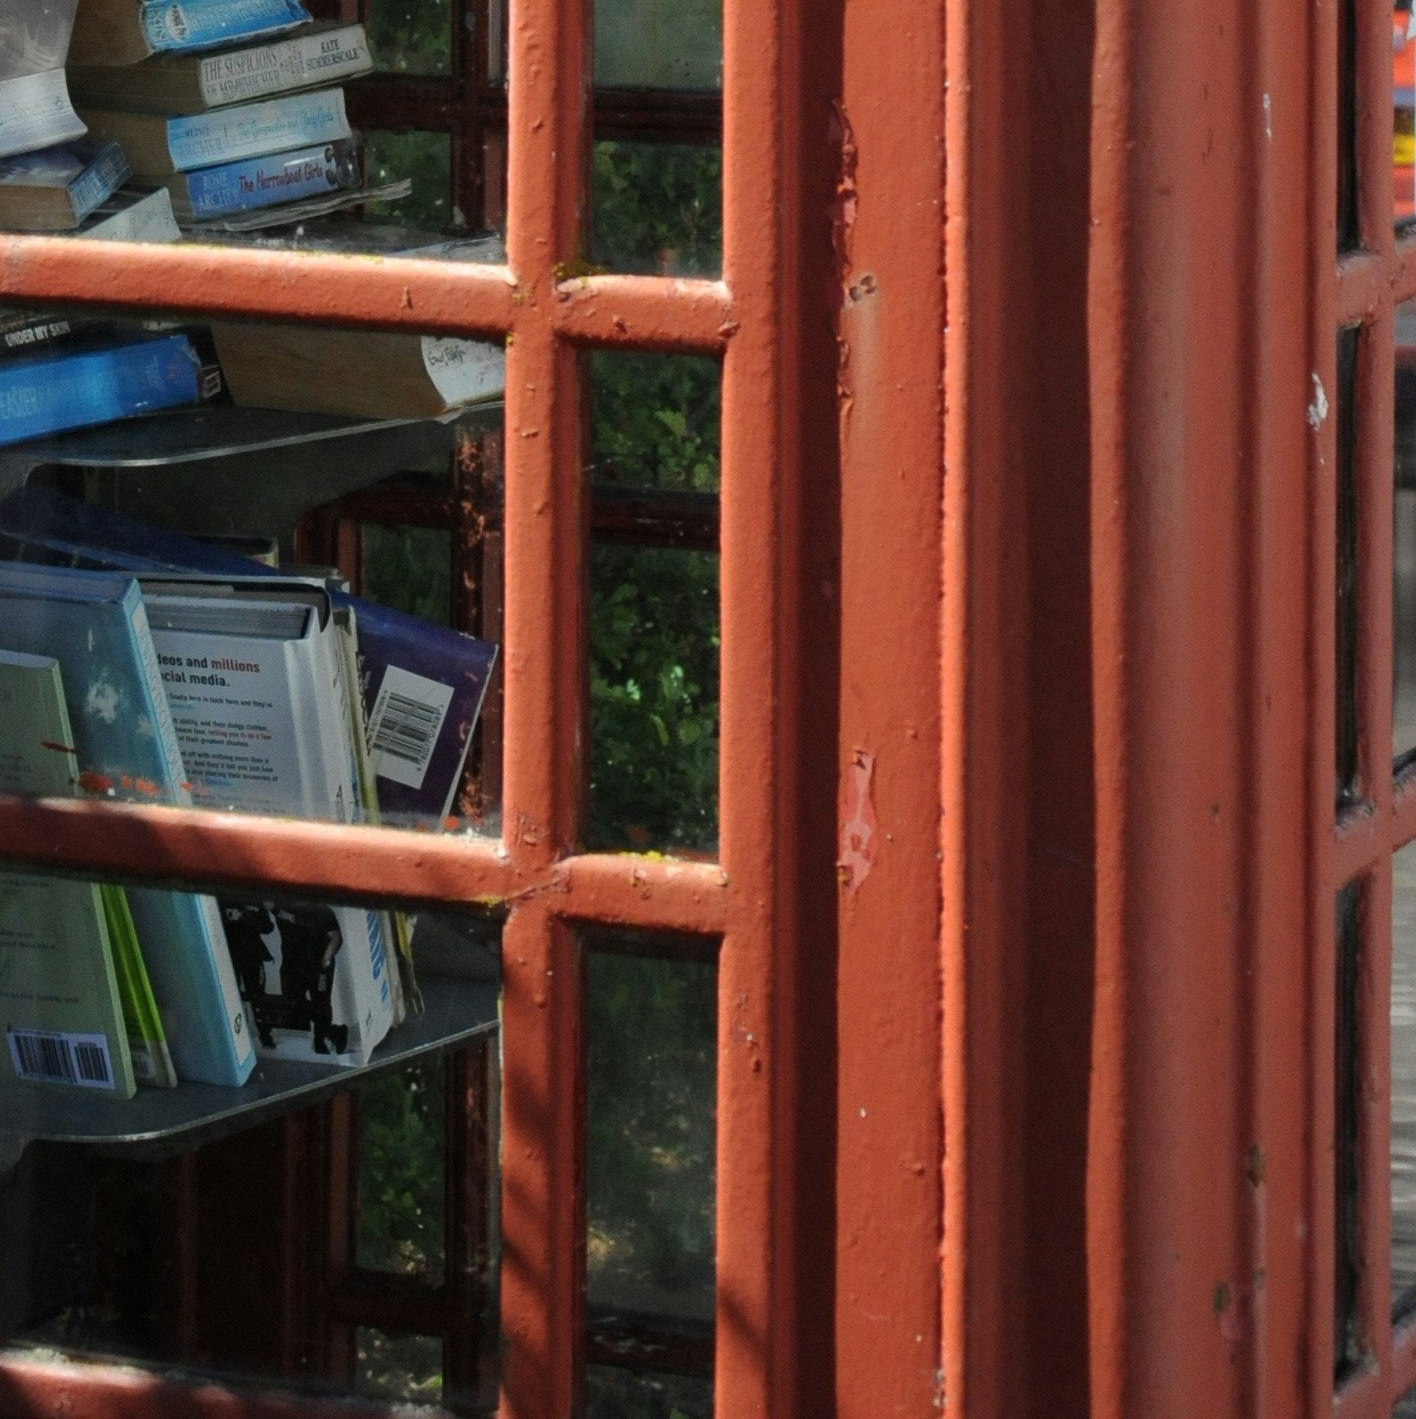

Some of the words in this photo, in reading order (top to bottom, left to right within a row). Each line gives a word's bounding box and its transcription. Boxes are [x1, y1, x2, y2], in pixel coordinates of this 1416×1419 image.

[320, 38, 341, 54] KATE
[203, 60, 223, 83] THE
[223, 47, 278, 77] SUSPICIONS
[305, 47, 360, 71] SUMMERSCALE
[237, 175, 255, 195] The
[255, 166, 303, 192] Narrowboat
[303, 161, 324, 182] Girls
[4, 328, 35, 348] UNDER
[34, 325, 49, 341] MY
[48, 320, 72, 338] SKIN
[185, 656, 209, 669] and
[210, 658, 262, 674] millions
[189, 672, 232, 688] media.
